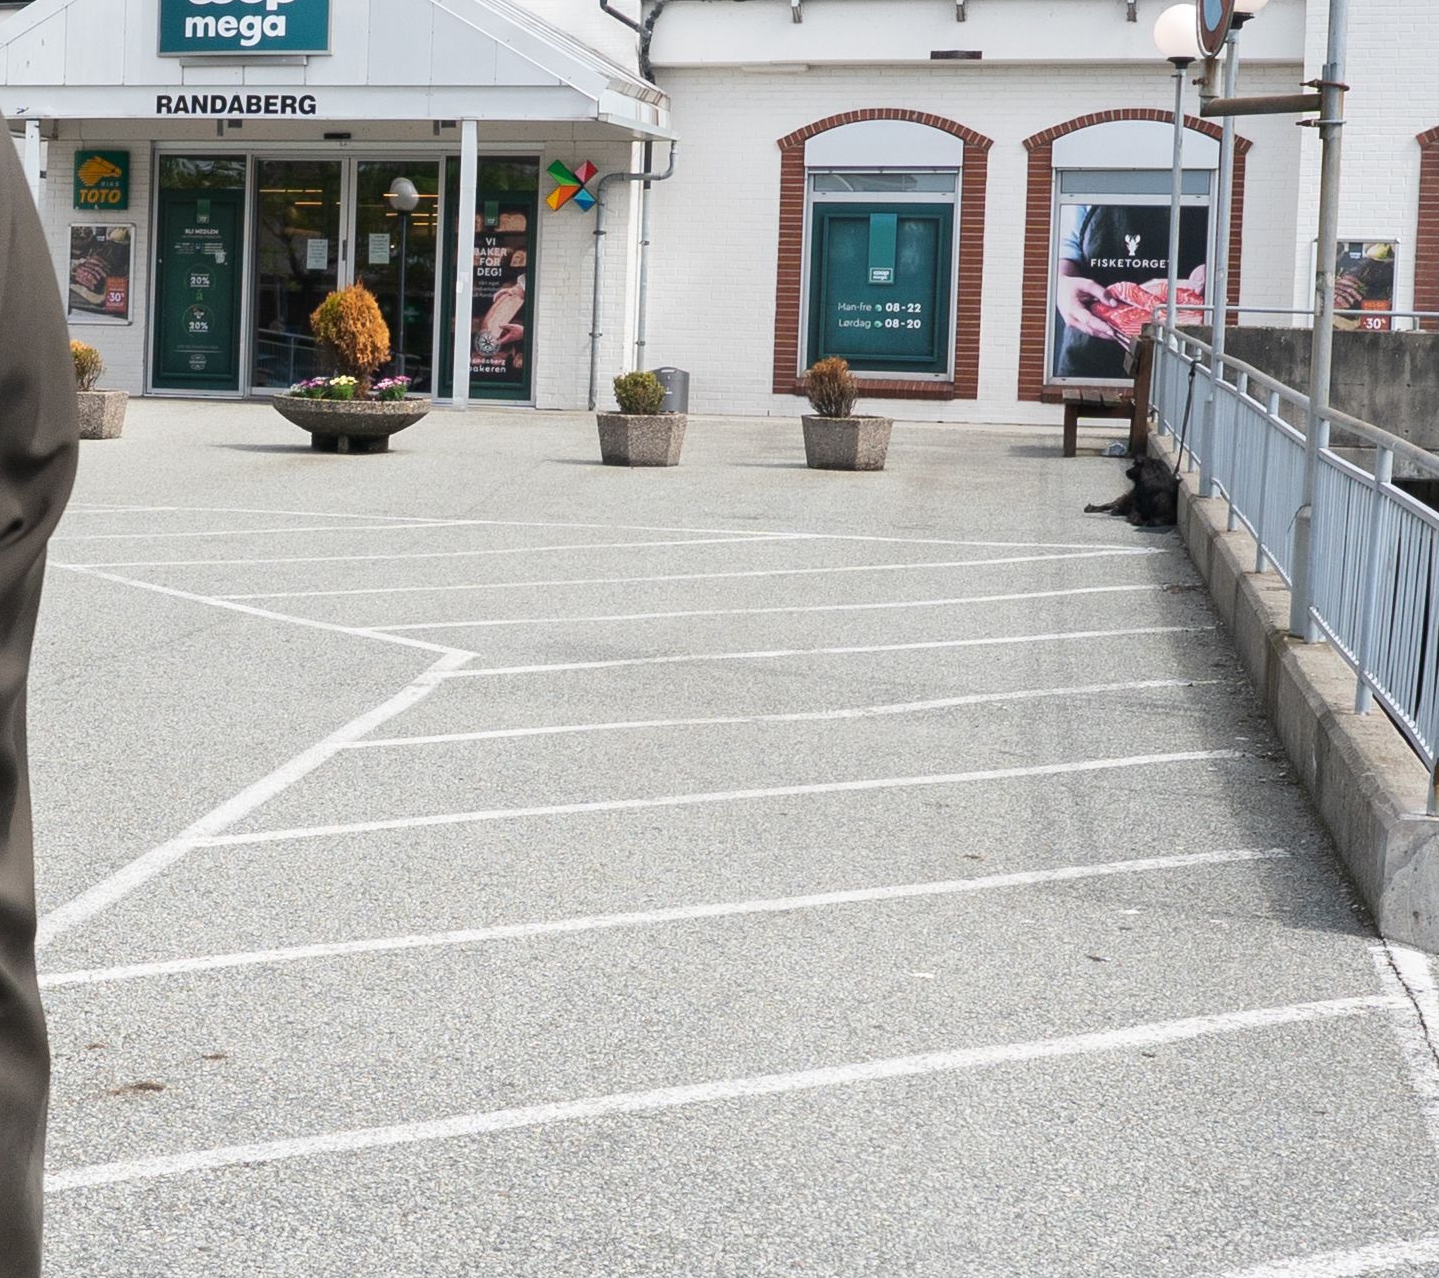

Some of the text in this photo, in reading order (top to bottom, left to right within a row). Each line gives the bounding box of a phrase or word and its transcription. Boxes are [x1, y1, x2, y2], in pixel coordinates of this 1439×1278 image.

[184, 14, 287, 47] mega
[156, 94, 317, 115] RANDABERG
[79, 189, 121, 203] TOTO
[485, 237, 496, 246] VI
[473, 247, 507, 257] BAKER
[479, 257, 501, 267] FOR
[1090, 258, 1170, 269] FISKETORGE
[476, 267, 502, 277] DEG!
[190, 276, 210, 285] 20%
[838, 302, 873, 312] Man-fre
[838, 319, 871, 330] Lørdag
